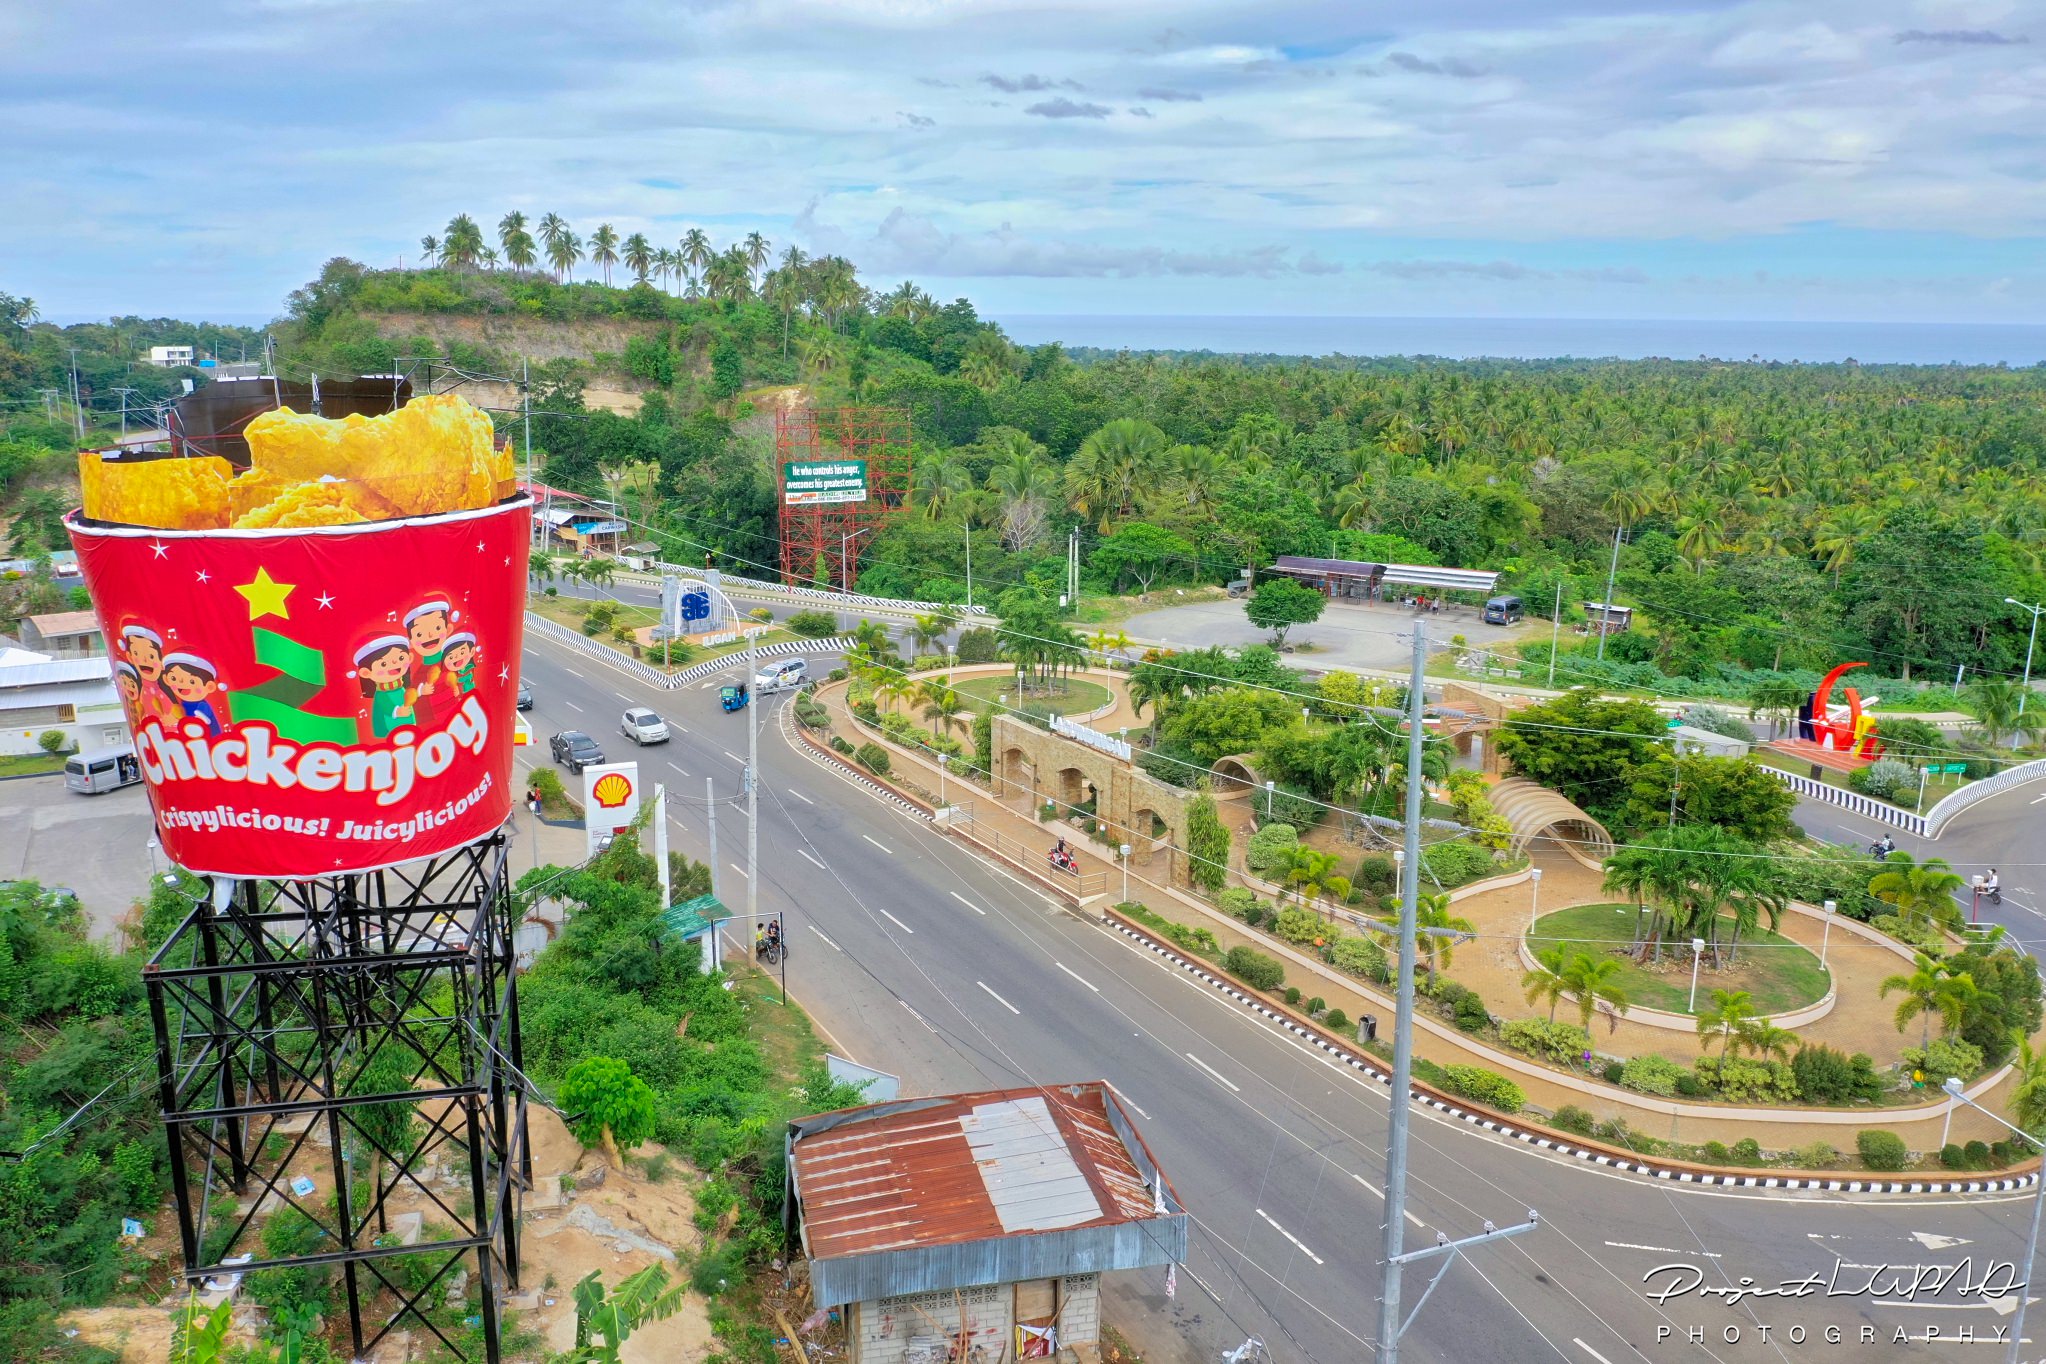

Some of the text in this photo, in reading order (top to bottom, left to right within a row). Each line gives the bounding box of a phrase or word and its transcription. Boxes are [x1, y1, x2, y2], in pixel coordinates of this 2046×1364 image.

[787, 480, 814, 490] overcomes
[815, 478, 823, 488] his
[823, 479, 845, 490] greatest
[792, 464, 860, 476] He who controls his anger,
[137, 694, 489, 807] Chickenjoy
[335, 771, 493, 843] Juicylicious!
